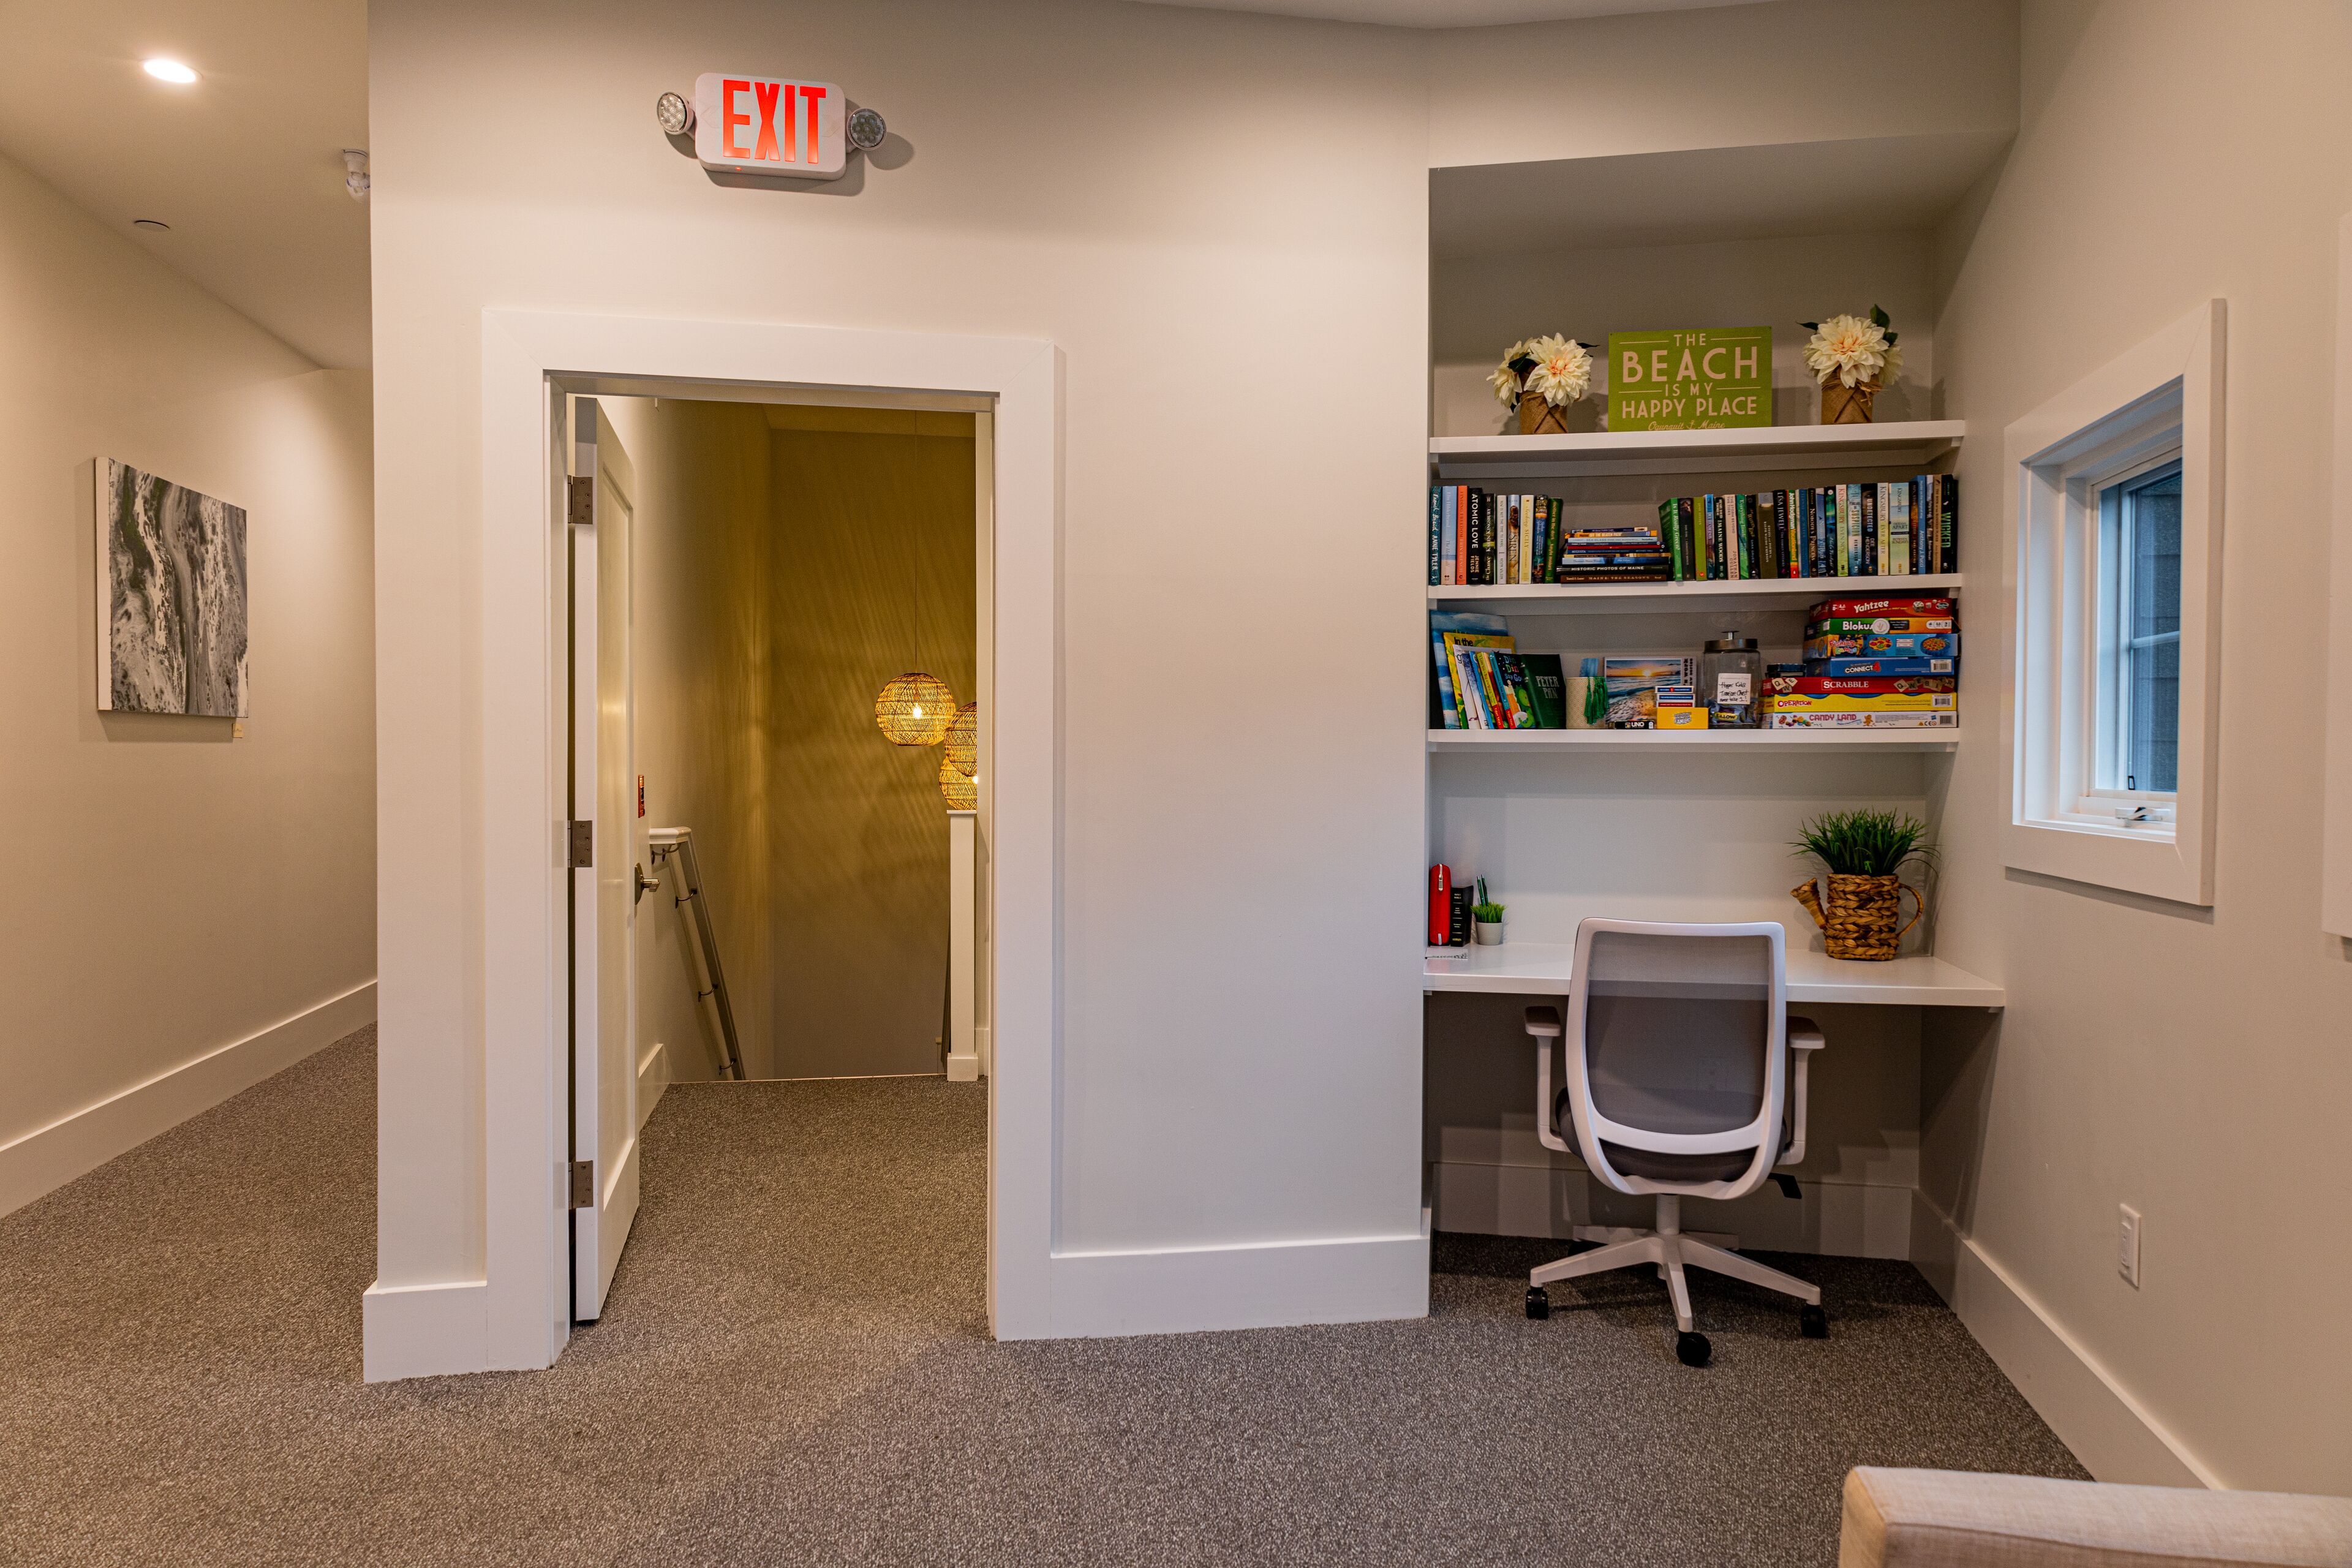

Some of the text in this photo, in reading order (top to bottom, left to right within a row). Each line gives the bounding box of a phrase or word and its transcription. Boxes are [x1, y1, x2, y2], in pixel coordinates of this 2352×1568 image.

[723, 79, 827, 164] EXIT
[1673, 333, 1707, 347] THE
[1623, 346, 1758, 383] BEACH
[1665, 382, 1713, 396] IS MY
[1622, 396, 1757, 419] HAPPY PLACE
[1698, 420, 1725, 429] Maine
[1940, 512, 1951, 548] WICKED
[1509, 535, 1518, 562] SIREN
[1853, 601, 1890, 614] Yahtzee
[1453, 636, 1474, 647] In the
[1506, 664, 1520, 673] Din
[1873, 662, 1881, 673] 4
[1536, 676, 1560, 688] PETER
[1543, 688, 1559, 699] PAN
